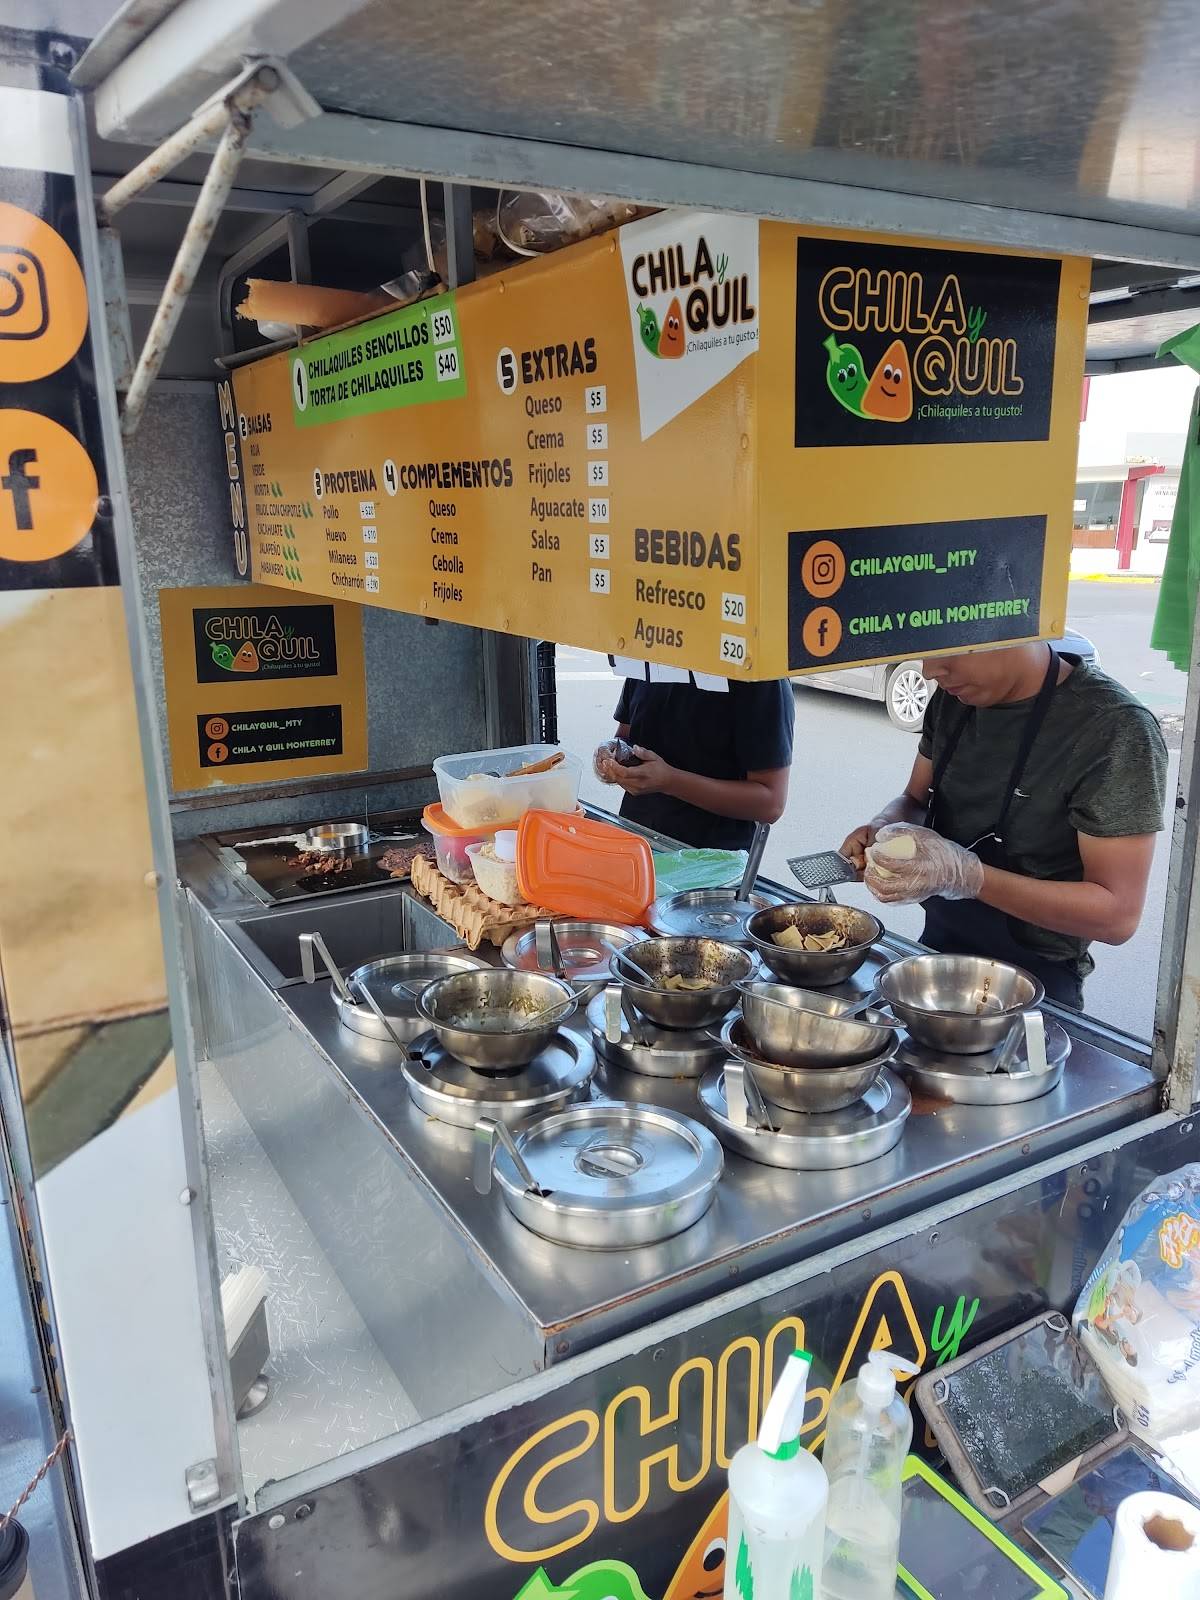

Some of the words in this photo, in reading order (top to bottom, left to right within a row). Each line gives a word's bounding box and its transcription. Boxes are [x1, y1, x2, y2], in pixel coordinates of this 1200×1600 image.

[632, 235, 714, 297] CHILA
[716, 253, 728, 285] y
[686, 273, 756, 334] QUIL
[818, 266, 966, 335] CHILA
[968, 306, 987, 343] y
[308, 344, 363, 379] CHILAQUILES
[366, 322, 429, 361] SENCILLOS
[434, 315, 452, 339] $50
[728, 335, 735, 344] tu
[500, 354, 515, 389] 5
[521, 337, 597, 384] EXTRAS
[913, 335, 1024, 396] QUIL
[310, 385, 336, 407] TORTA
[338, 380, 349, 401] DE
[351, 359, 424, 396] CHILAQUILES
[438, 353, 457, 377] $40
[525, 395, 562, 418] Queso
[590, 391, 601, 408] $5
[917, 404, 973, 420] ¡Chilaquiles
[974, 406, 981, 416] a
[982, 405, 993, 416] tu
[994, 404, 1023, 420] gusto!
[248, 413, 272, 435] SALSAS
[527, 430, 564, 450] Crema
[592, 428, 603, 444] $5
[217, 380, 248, 576] MENU
[324, 469, 378, 494] PROTEINA
[386, 465, 395, 491] 4
[400, 458, 513, 489] COMPLEMENTOS
[528, 461, 571, 488] Frijoles
[593, 465, 604, 481] $5
[323, 505, 339, 519] Pollo
[429, 499, 457, 518] Queso
[530, 497, 585, 522] Aguacate
[591, 504, 607, 517] $10
[325, 528, 347, 542] Huevo
[431, 527, 459, 545] Crema
[531, 529, 560, 551] Salsa
[594, 538, 605, 553] $5
[328, 549, 357, 565] Milanesa
[635, 528, 742, 572] BEBIDAS
[432, 555, 464, 574] Cebolla
[532, 562, 552, 583] Pan
[595, 572, 605, 588] $5
[850, 549, 977, 577] CHILAYQUIL_MTY
[331, 570, 365, 589] Chicharrón
[433, 581, 463, 603] Frijoles
[636, 578, 706, 611] Refresco
[724, 597, 744, 617] $20
[205, 615, 284, 640] CHILA
[850, 614, 893, 635] CHILA
[897, 612, 906, 629] Y
[909, 609, 943, 628] QUIL
[946, 598, 1030, 623] MONTERREY
[258, 637, 320, 661] QUIL
[635, 617, 683, 649] Aguas
[723, 640, 744, 659] $20
[231, 719, 302, 732] CHILAYQUIL_MTY
[232, 743, 257, 755] CHILA
[258, 743, 264, 752] Y
[265, 741, 285, 752] QUIL
[286, 738, 337, 750] MONTERREY
[485, 1270, 926, 1563] CHILA
[930, 1295, 980, 1367] y
